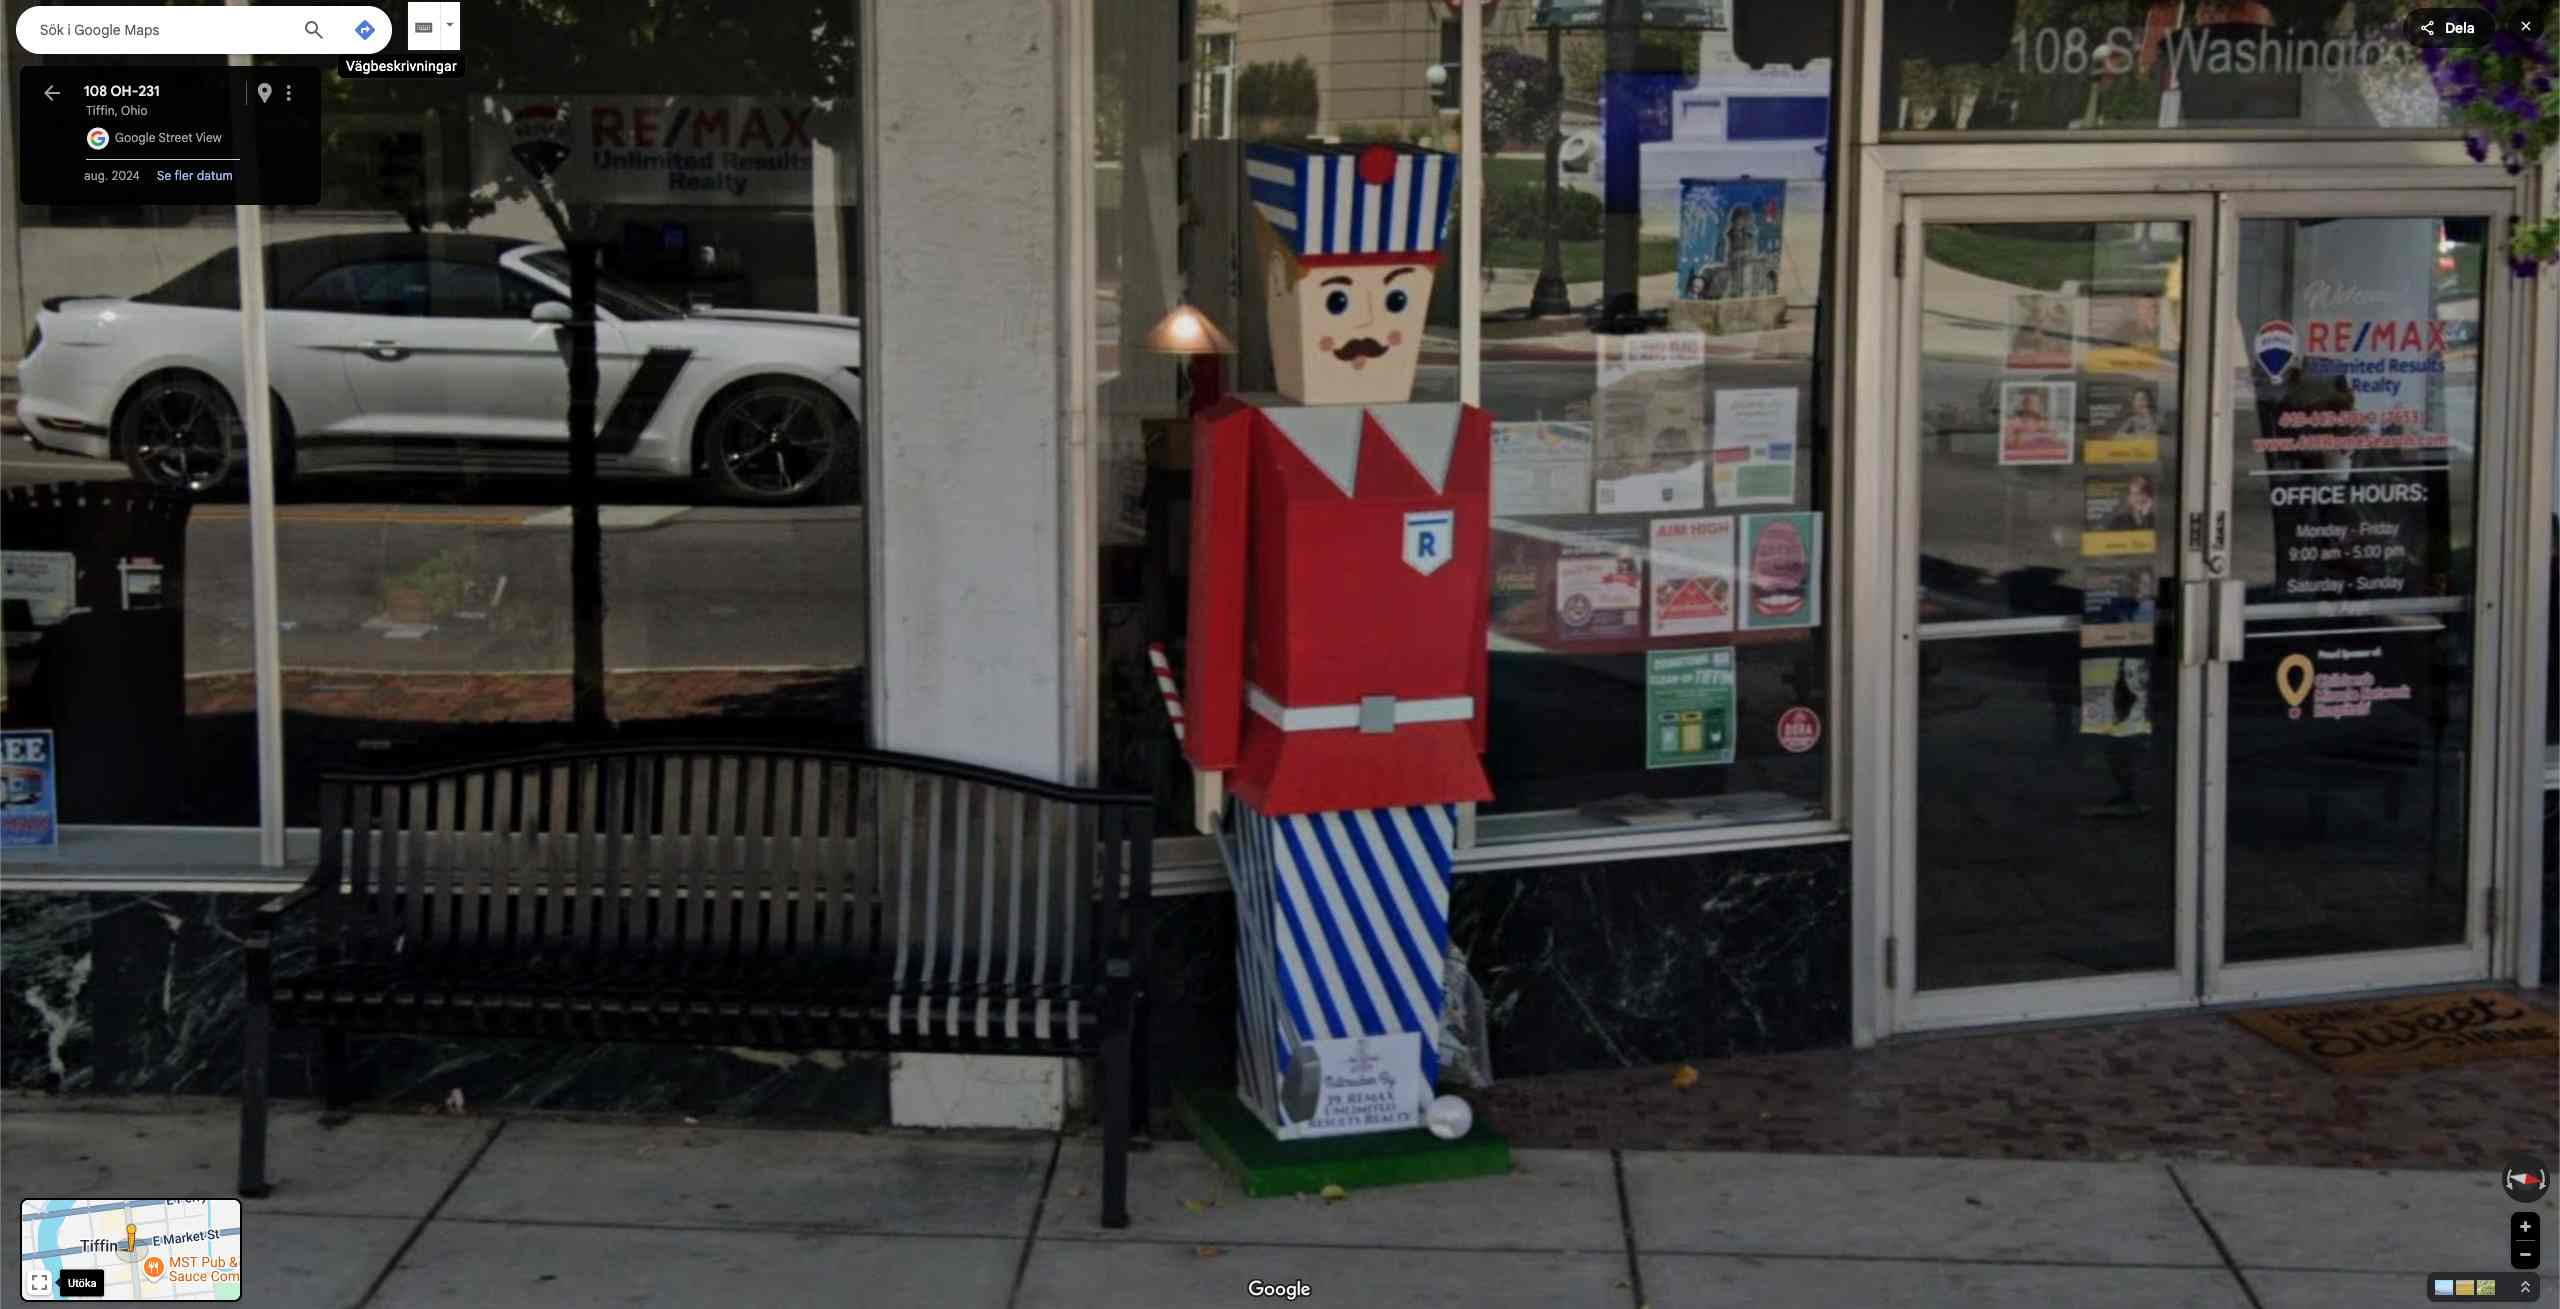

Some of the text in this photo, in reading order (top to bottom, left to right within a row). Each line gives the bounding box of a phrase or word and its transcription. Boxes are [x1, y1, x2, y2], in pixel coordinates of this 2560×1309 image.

[2011, 27, 2088, 74] 108
[592, 105, 812, 148] RE/MAX
[594, 150, 713, 171] Unlimited
[669, 172, 749, 195] Realty
[2306, 320, 2447, 352] RE/MAX
[2389, 356, 2445, 374] Results
[2352, 377, 2402, 396] Realty
[2270, 483, 2429, 506] OFFICE HOURS:
[1690, 521, 1729, 537] HIGH
[2296, 523, 2348, 540] Monday
[2359, 521, 2400, 538] Friday
[1417, 530, 1436, 559] R
[2288, 547, 2319, 561] 9:00
[2320, 549, 2343, 559] am
[2352, 545, 2382, 559] 5:00
[2384, 547, 2406, 561] pm
[2287, 578, 2344, 594] Saturday
[2355, 576, 2405, 592] Sunday
[1, 737, 46, 763] EE
